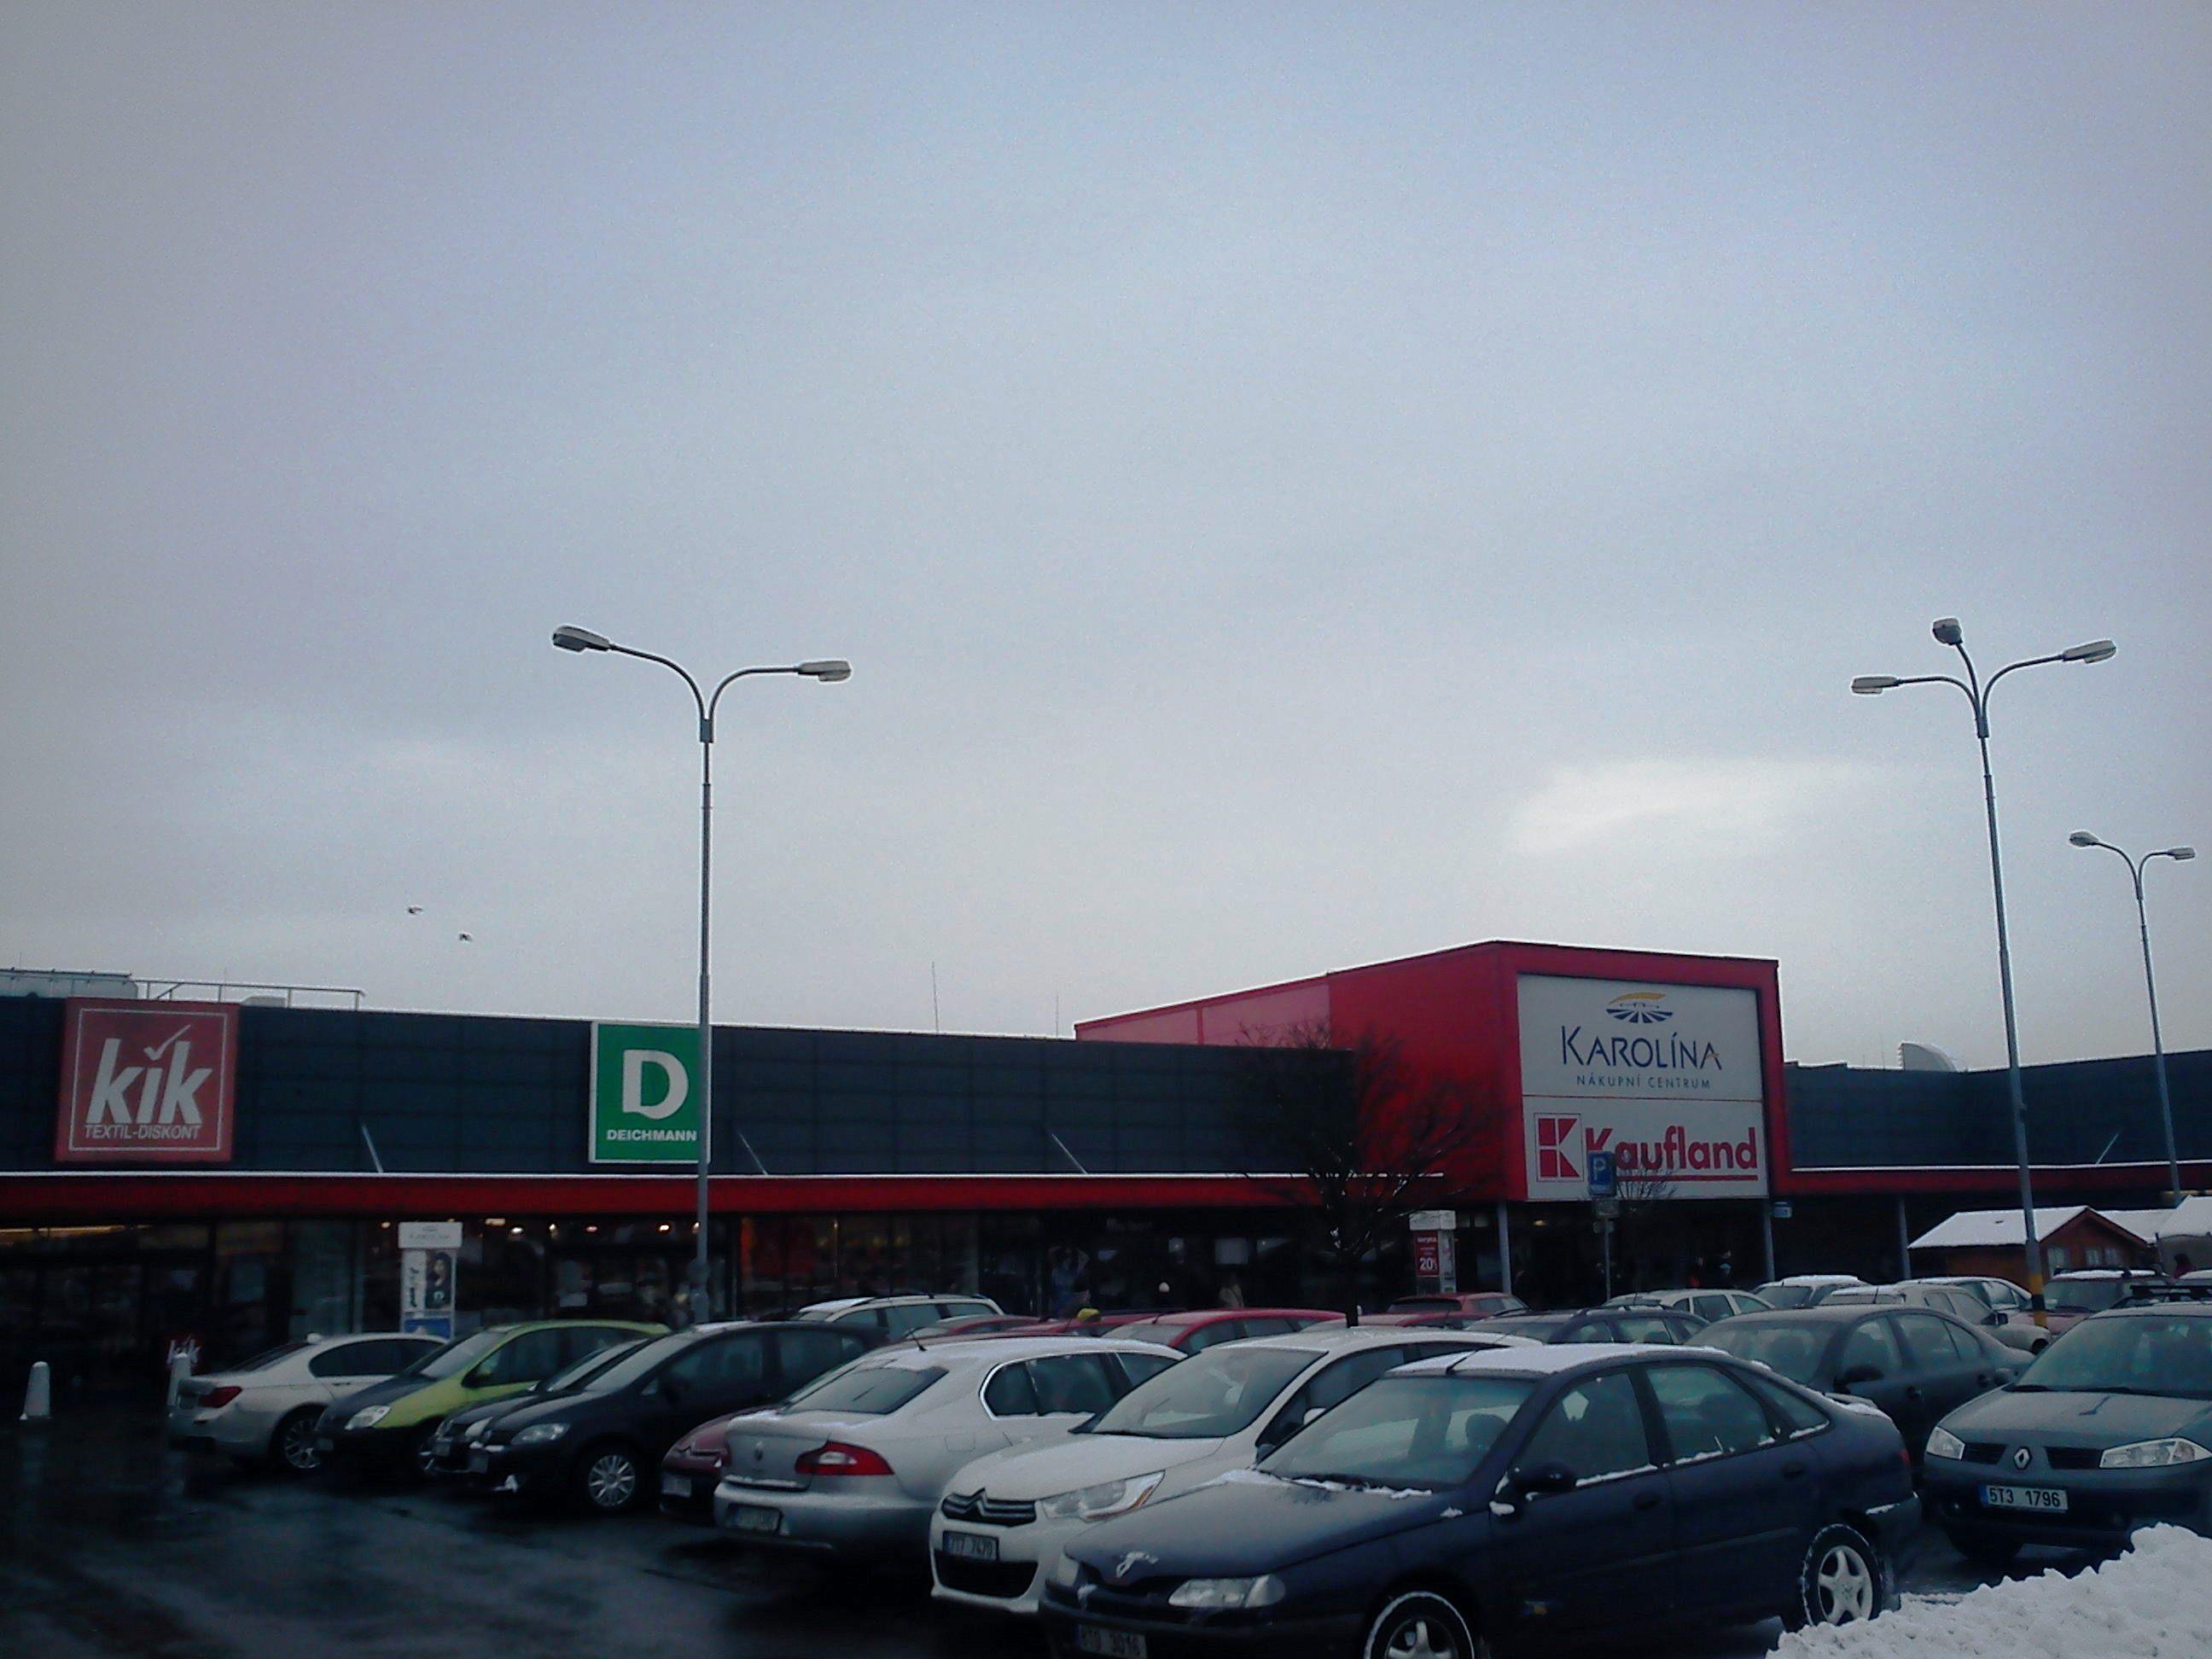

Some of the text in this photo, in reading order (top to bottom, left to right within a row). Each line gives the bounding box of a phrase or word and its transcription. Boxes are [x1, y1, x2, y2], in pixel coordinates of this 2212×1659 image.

[1561, 1026, 1722, 1070] KAROLÍNA
[622, 1040, 690, 1121] D
[1576, 1072, 1711, 1090] NÁKUPNÍ CENTRUM
[84, 1124, 202, 1140] TEXTIL-DISKONT
[606, 1128, 697, 1142] DEICHMANN
[1592, 1156, 1606, 1182] P
[1988, 1487, 2061, 1507] 5T3 1796
